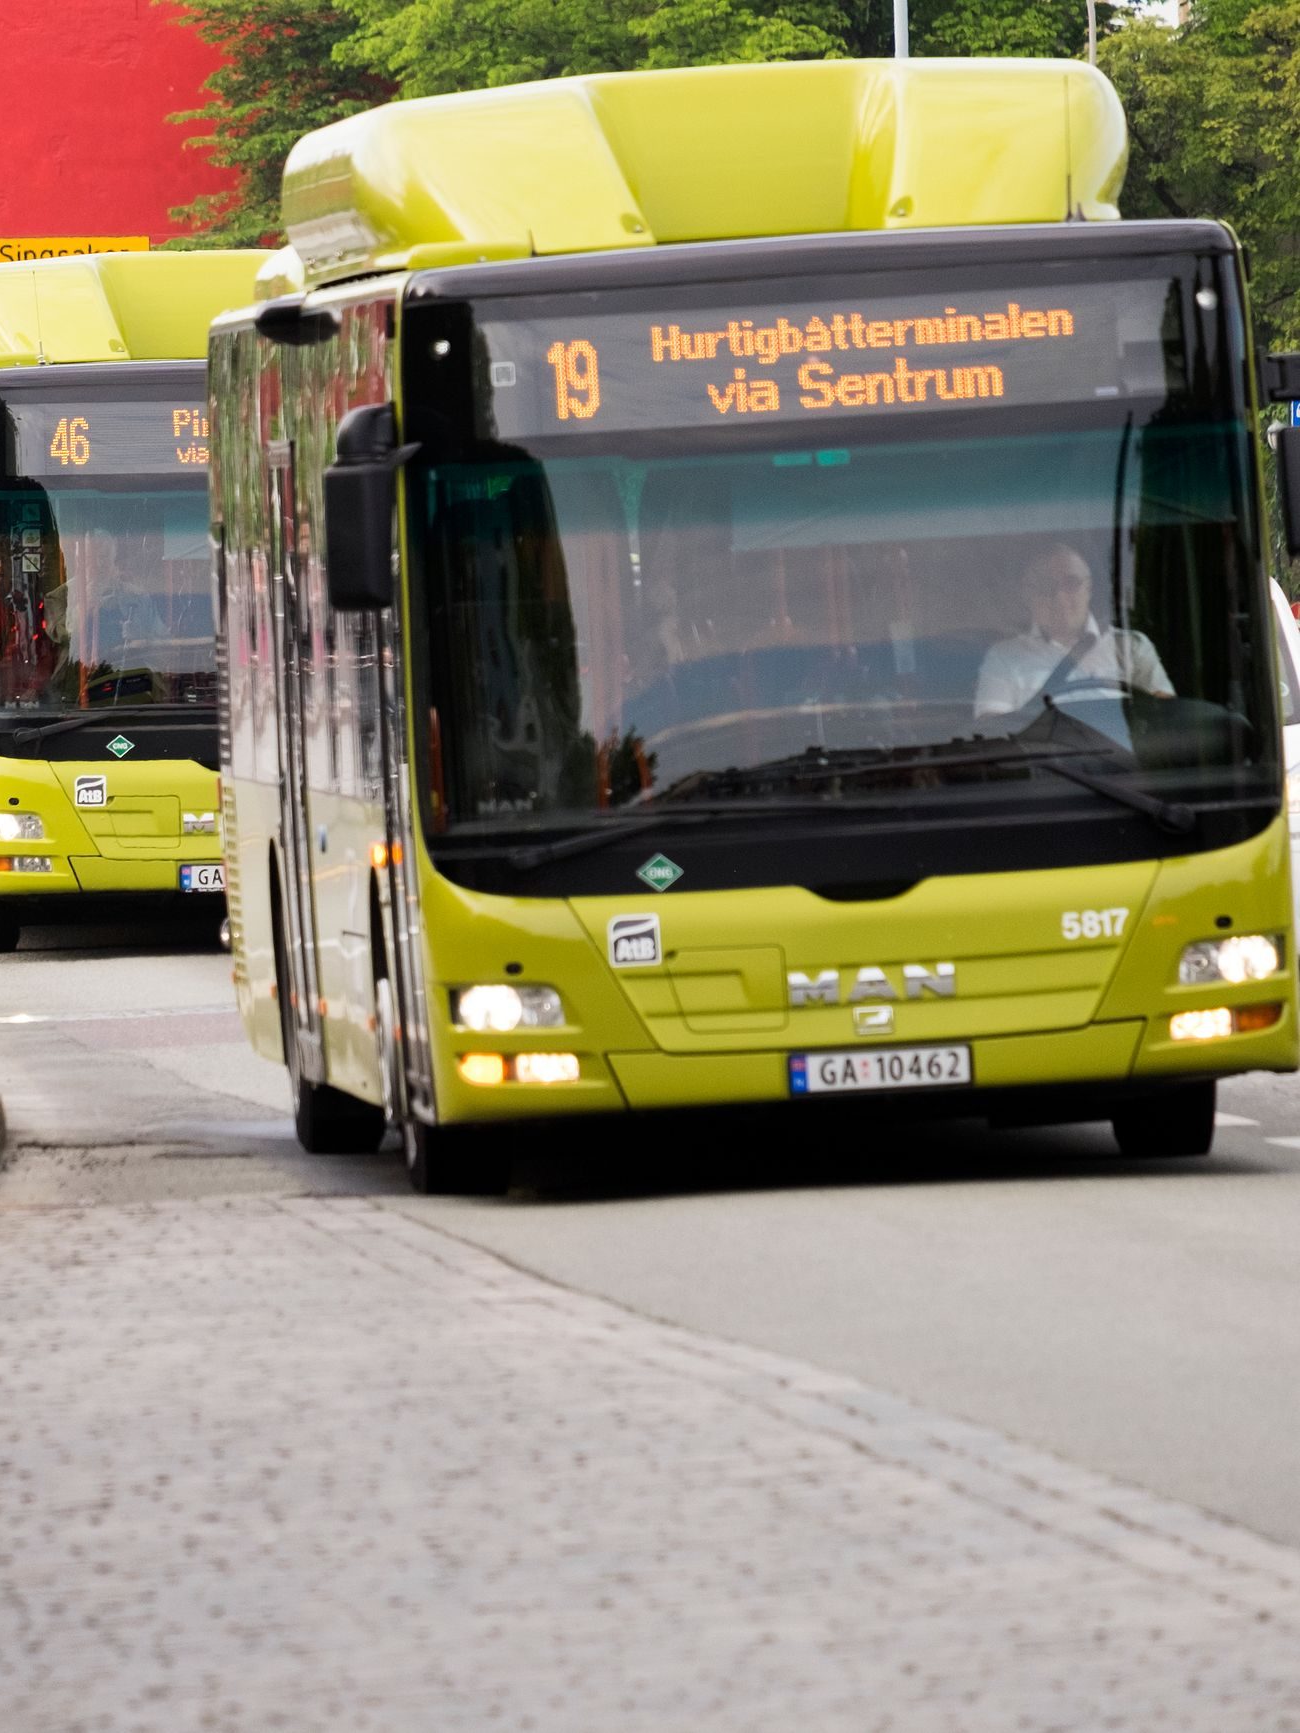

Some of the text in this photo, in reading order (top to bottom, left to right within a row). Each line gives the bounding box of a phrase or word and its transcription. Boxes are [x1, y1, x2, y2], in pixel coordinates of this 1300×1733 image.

[548, 341, 599, 419] 19
[707, 358, 1004, 414] via Sentrum
[50, 418, 90, 465] 46
[1061, 908, 1129, 940] 5817
[787, 963, 956, 1008] MAN
[819, 1058, 858, 1085] GA
[876, 1052, 961, 1081] 10462
